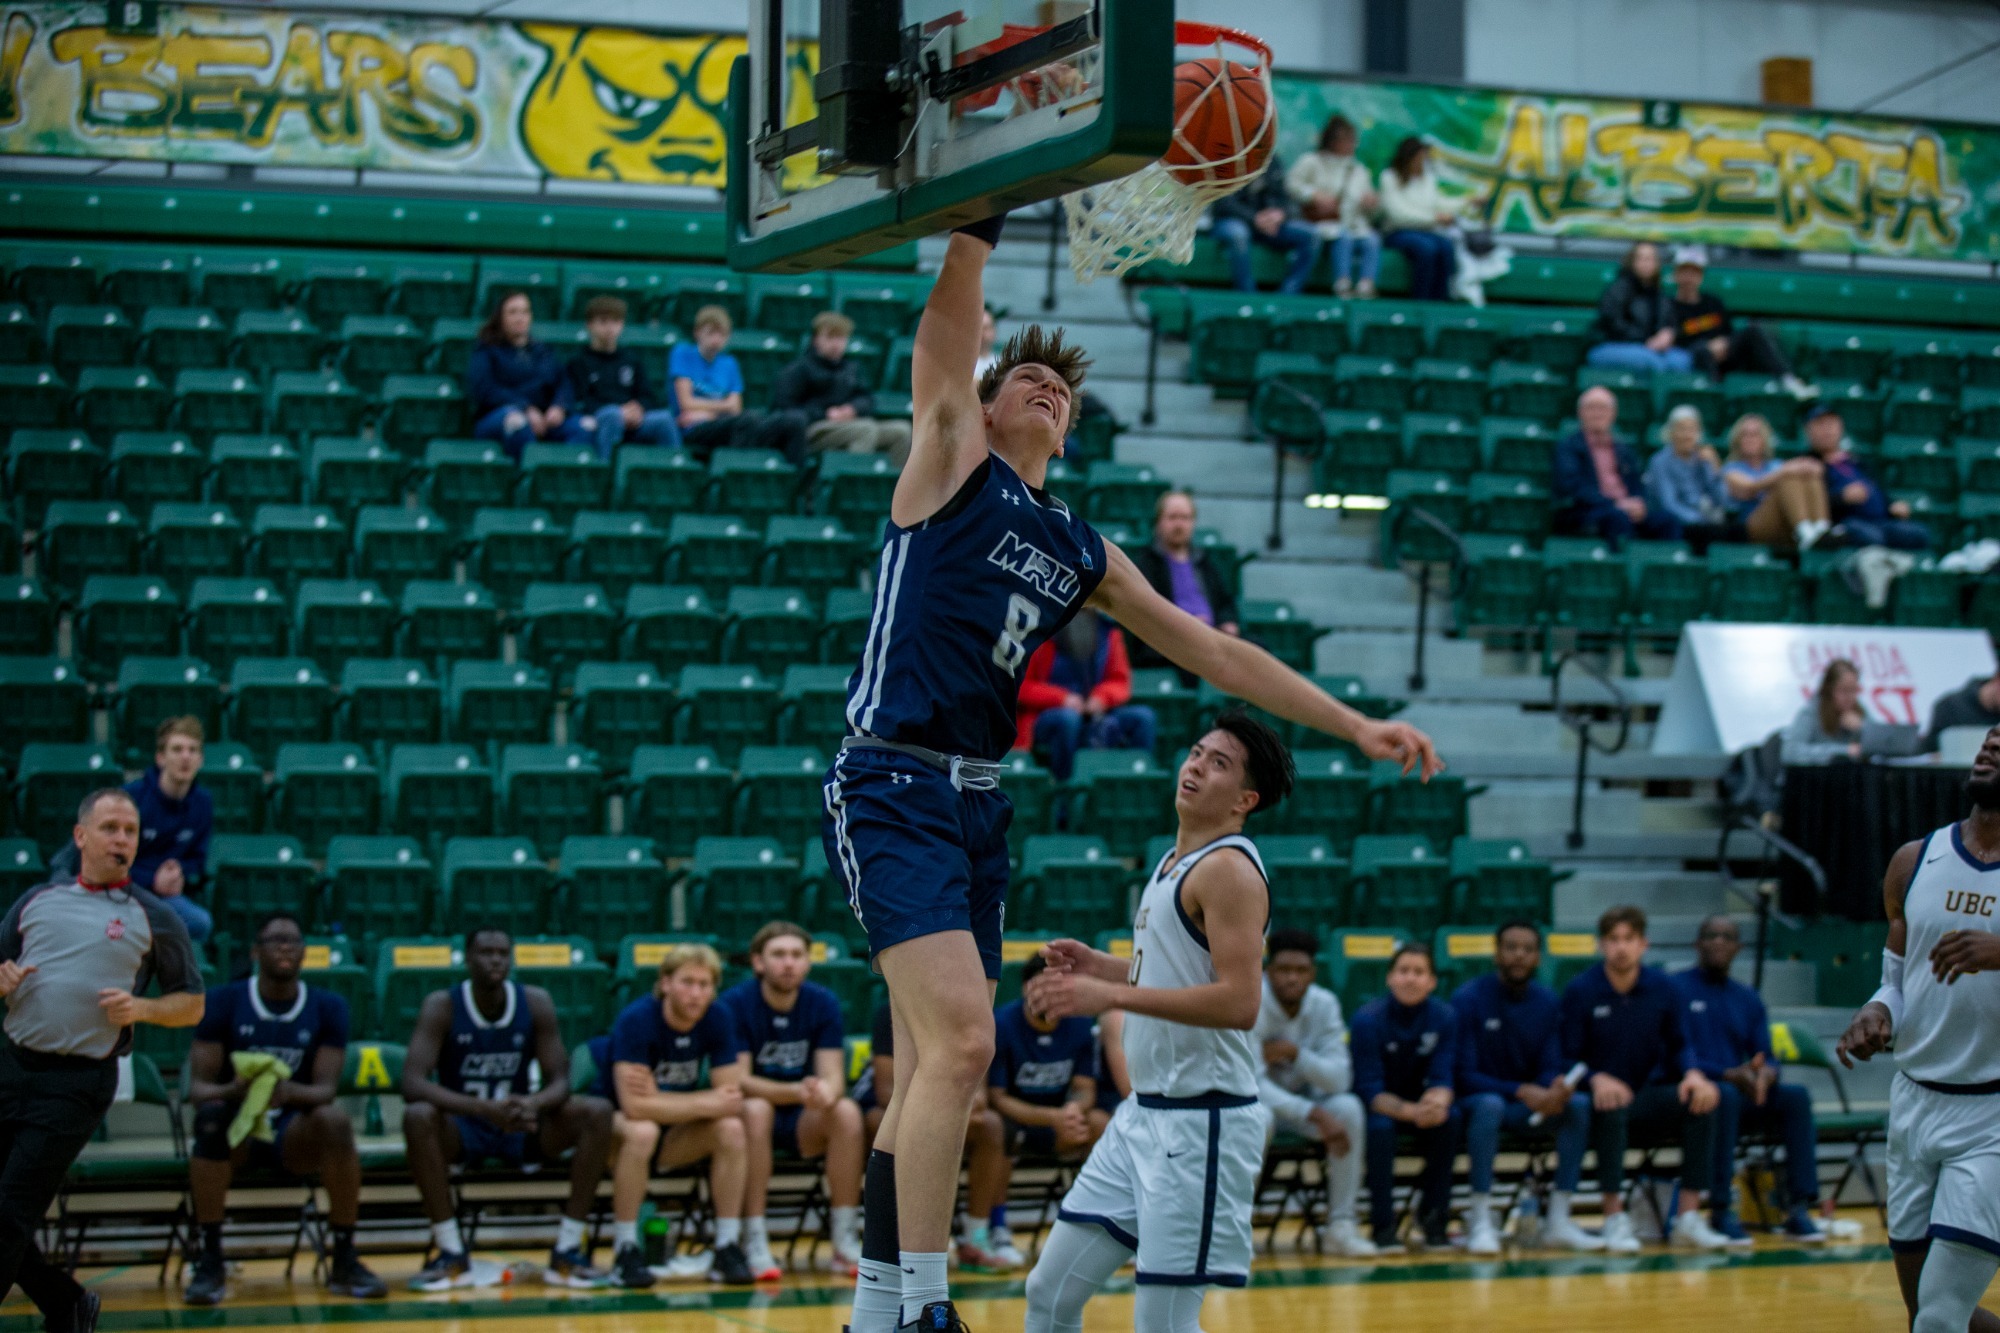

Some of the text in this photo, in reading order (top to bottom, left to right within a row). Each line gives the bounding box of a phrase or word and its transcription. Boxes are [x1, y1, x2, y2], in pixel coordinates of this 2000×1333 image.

[52, 24, 482, 155] BEARS
[1483, 104, 1963, 246] ALBERTA
[988, 530, 1080, 607] MRU
[992, 594, 1041, 678] 8
[1945, 890, 1996, 917] UBC
[356, 1047, 391, 1088] A
